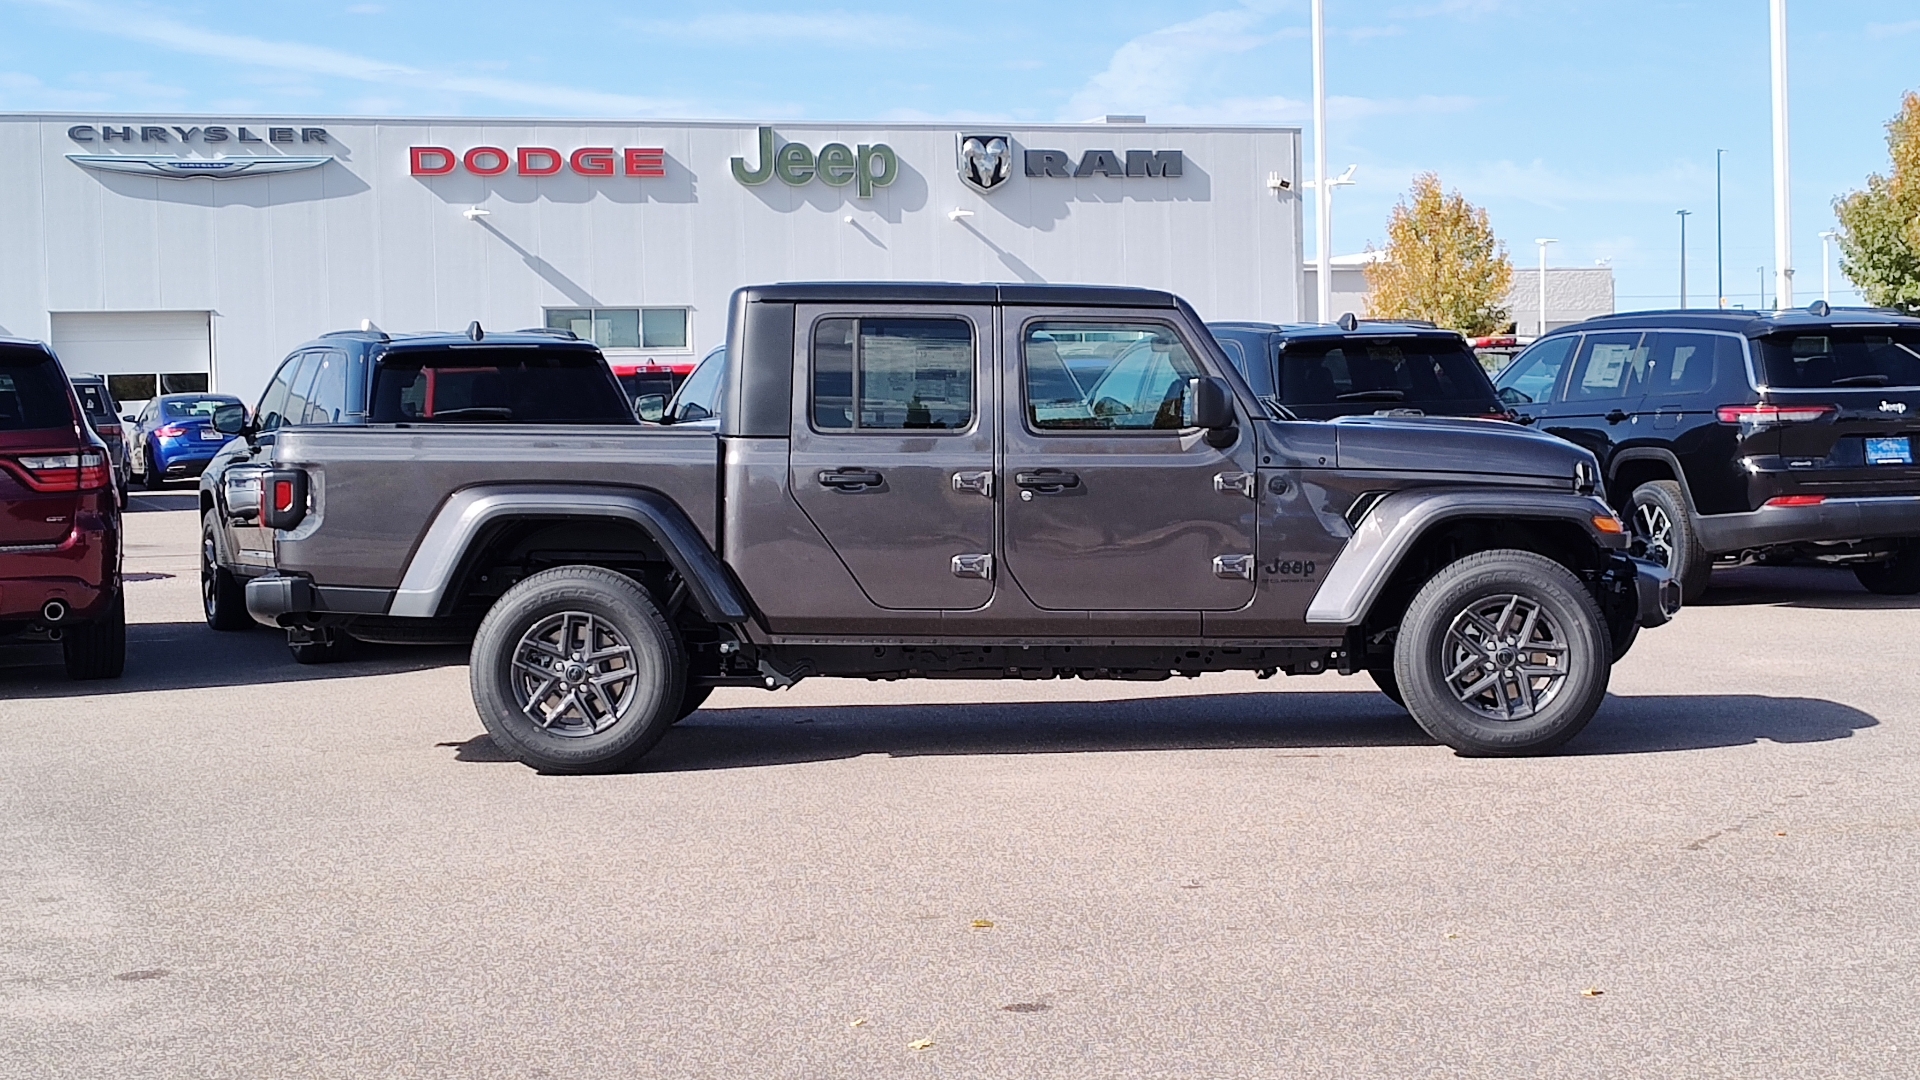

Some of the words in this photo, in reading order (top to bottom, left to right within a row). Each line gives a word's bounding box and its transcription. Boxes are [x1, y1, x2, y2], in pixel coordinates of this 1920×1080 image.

[67, 125, 328, 144] CHRYSLER
[409, 146, 666, 176] DODGE
[730, 126, 899, 198] Jeep
[1024, 149, 1184, 178] RAM
[1879, 401, 1907, 414] Jeep
[1265, 557, 1316, 577] Jeep
